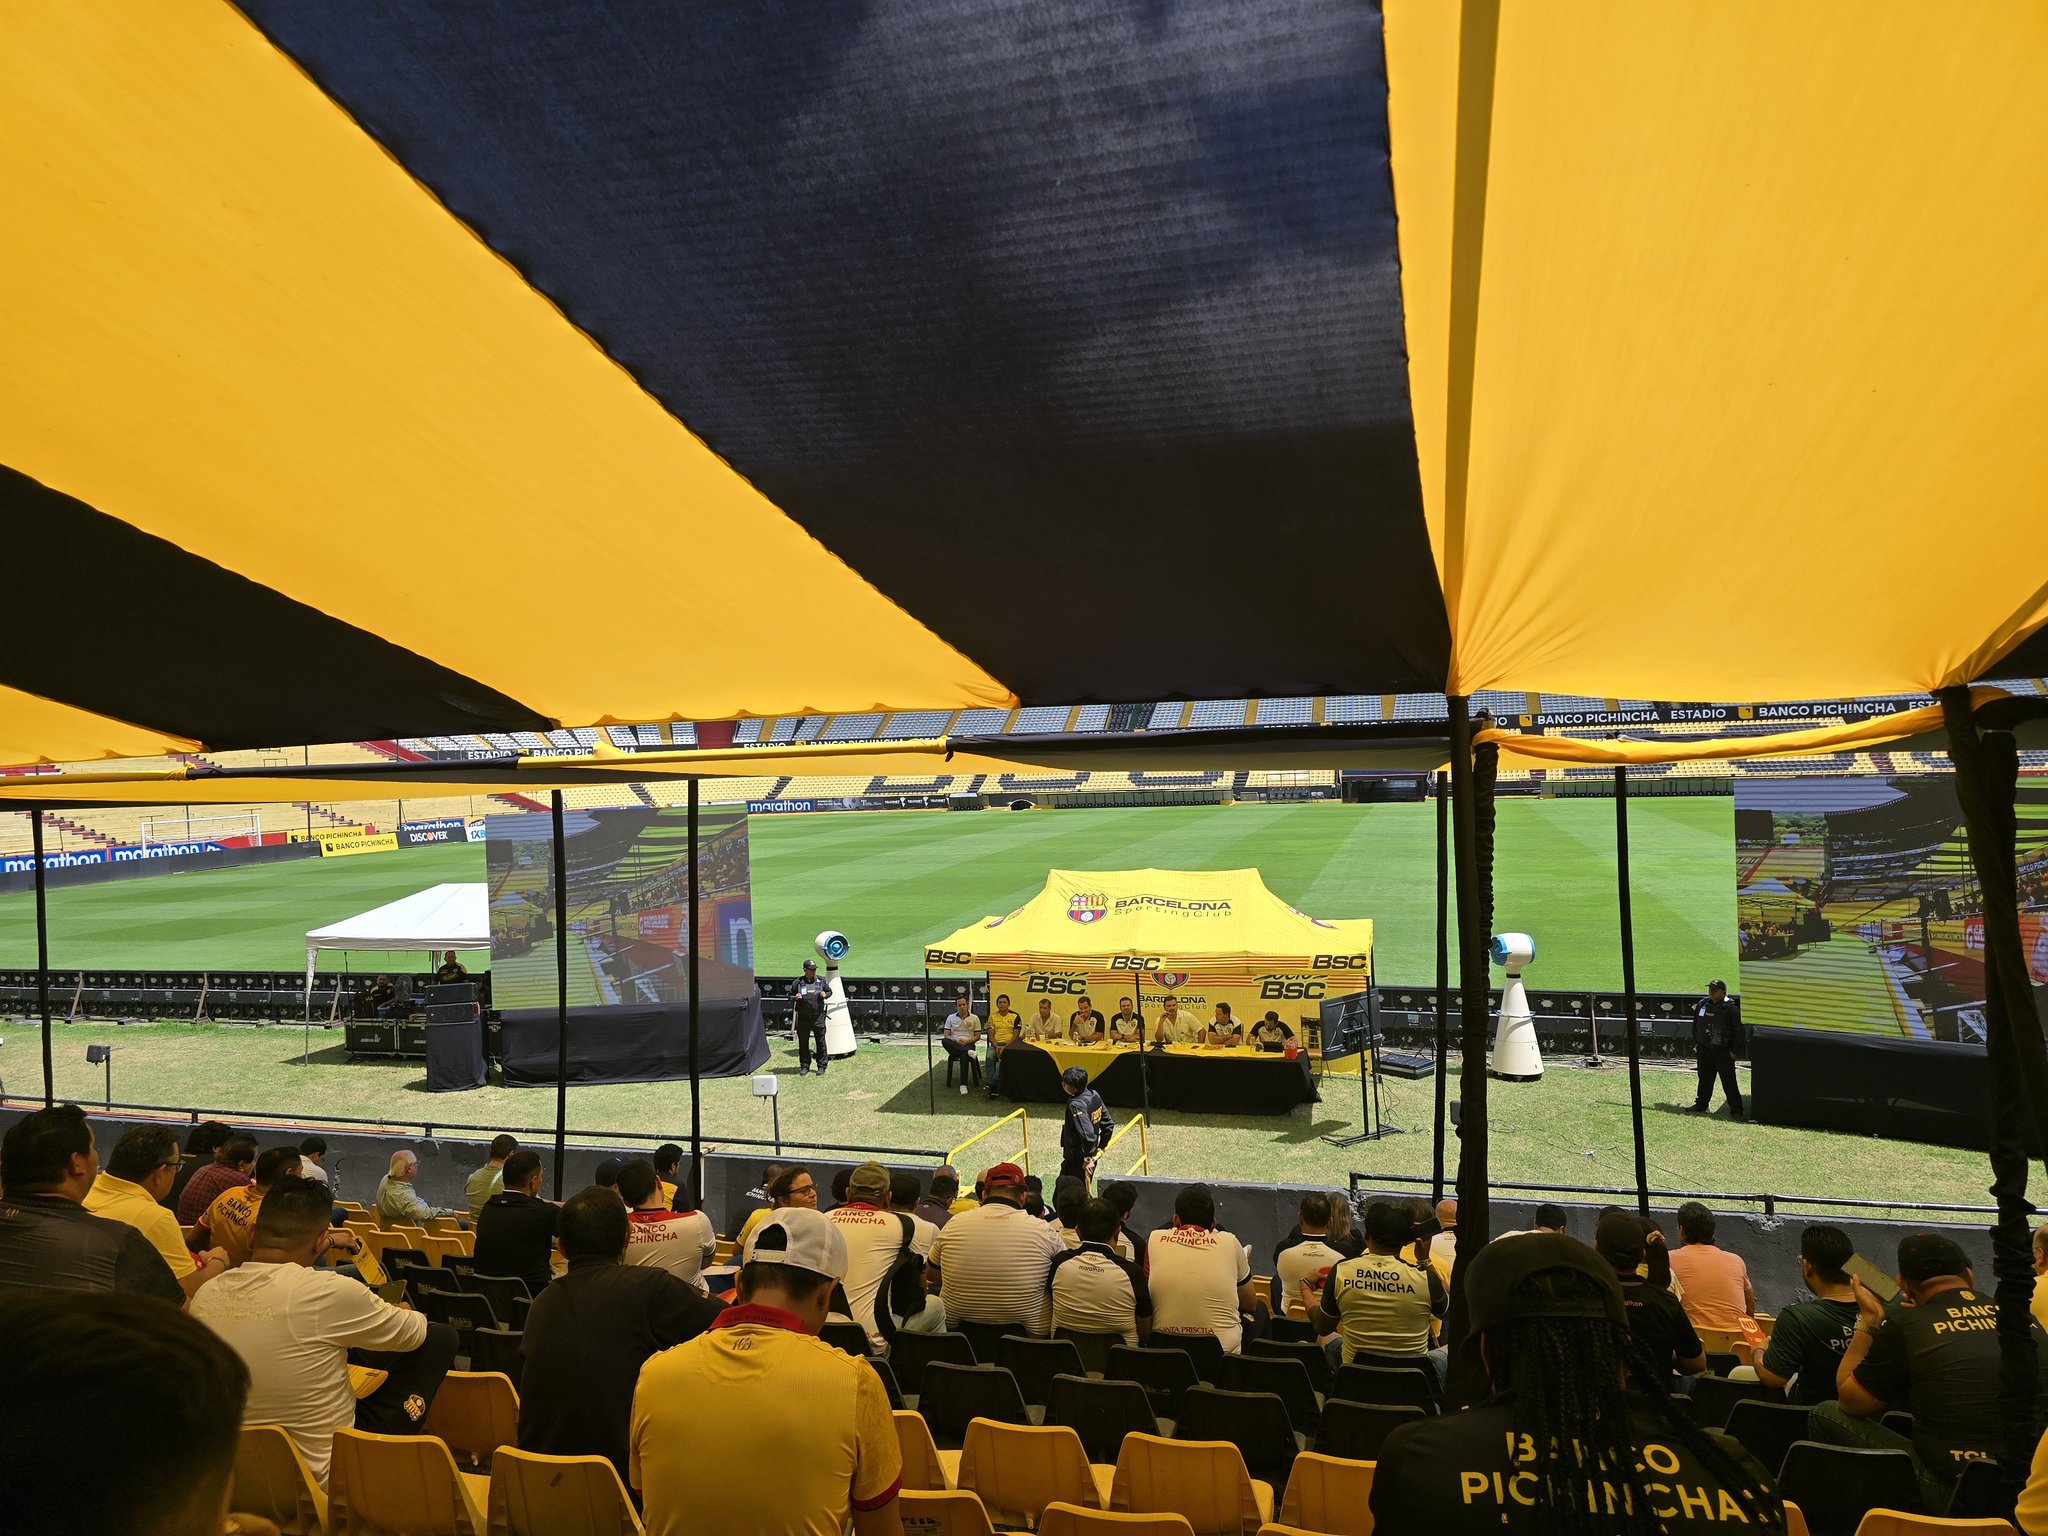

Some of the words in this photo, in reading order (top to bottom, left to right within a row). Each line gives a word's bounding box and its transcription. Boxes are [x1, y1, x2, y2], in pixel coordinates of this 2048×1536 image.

[1759, 704, 1810, 717] BANCO
[1813, 702, 1897, 715] PICHINCHA
[1908, 699, 1942, 711] ESTA
[1537, 714, 1583, 725] BANCO
[1586, 710, 1660, 723] PICHINCHA
[1671, 708, 1726, 720] ESTADIO
[468, 750, 511, 760] ESTADIO
[533, 748, 572, 757] BANCO
[750, 800, 811, 812] marathon
[301, 834, 326, 842] BANCO
[326, 831, 363, 840] PICHINCHA
[410, 830, 449, 842] DISCOVER
[471, 829, 486, 839] 1XB
[336, 842, 360, 851] BANCO
[361, 838, 395, 848] PICHINCHA
[5, 853, 102, 872] maathon
[1114, 896, 1231, 910] BARCELONA
[925, 949, 972, 964] BSC
[1110, 955, 1161, 970] BSC
[1312, 954, 1367, 969] BSC
[1027, 975, 1087, 995] BSC
[1260, 981, 1326, 999] BSC
[1139, 995, 1207, 1003] BARCLONA
[226, 1197, 252, 1218] BANCO
[830, 1217, 887, 1226] CHINCHA
[631, 1224, 667, 1234] BANCO
[1172, 1229, 1206, 1239] BANCO
[628, 1231, 678, 1245] CHINCHA
[1160, 1235, 1218, 1246] PICHINCHA
[1078, 1264, 1105, 1274] marathon
[1356, 1268, 1400, 1281] BANCO
[1344, 1278, 1416, 1294] PICHINCHA
[1946, 1304, 2000, 1319] BANC
[1181, 1326, 1215, 1335] PRISCILA
